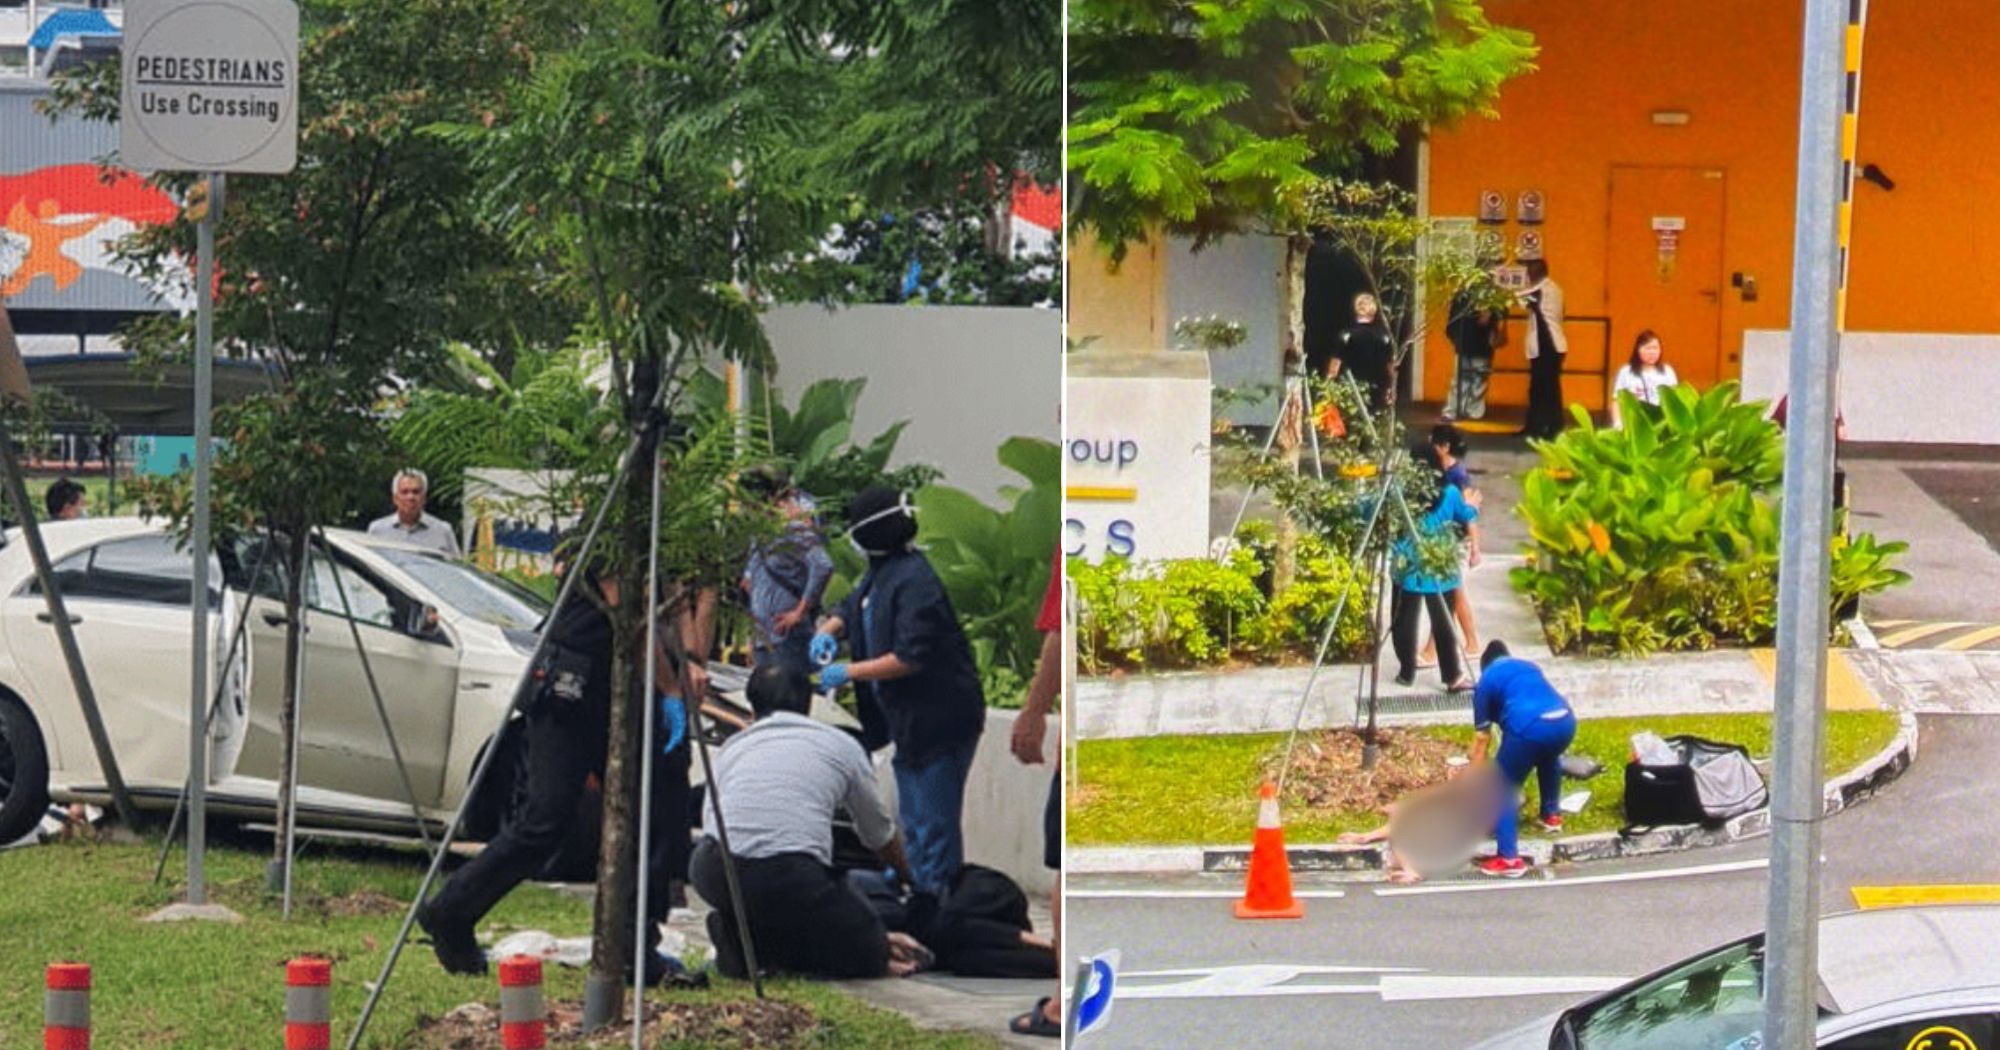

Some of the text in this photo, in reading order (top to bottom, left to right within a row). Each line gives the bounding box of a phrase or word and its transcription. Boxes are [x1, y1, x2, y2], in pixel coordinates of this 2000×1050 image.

[137, 55, 285, 82] PEDESTRIANS
[141, 92, 280, 123] Use Crossing
[1066, 438, 1138, 471] oup
